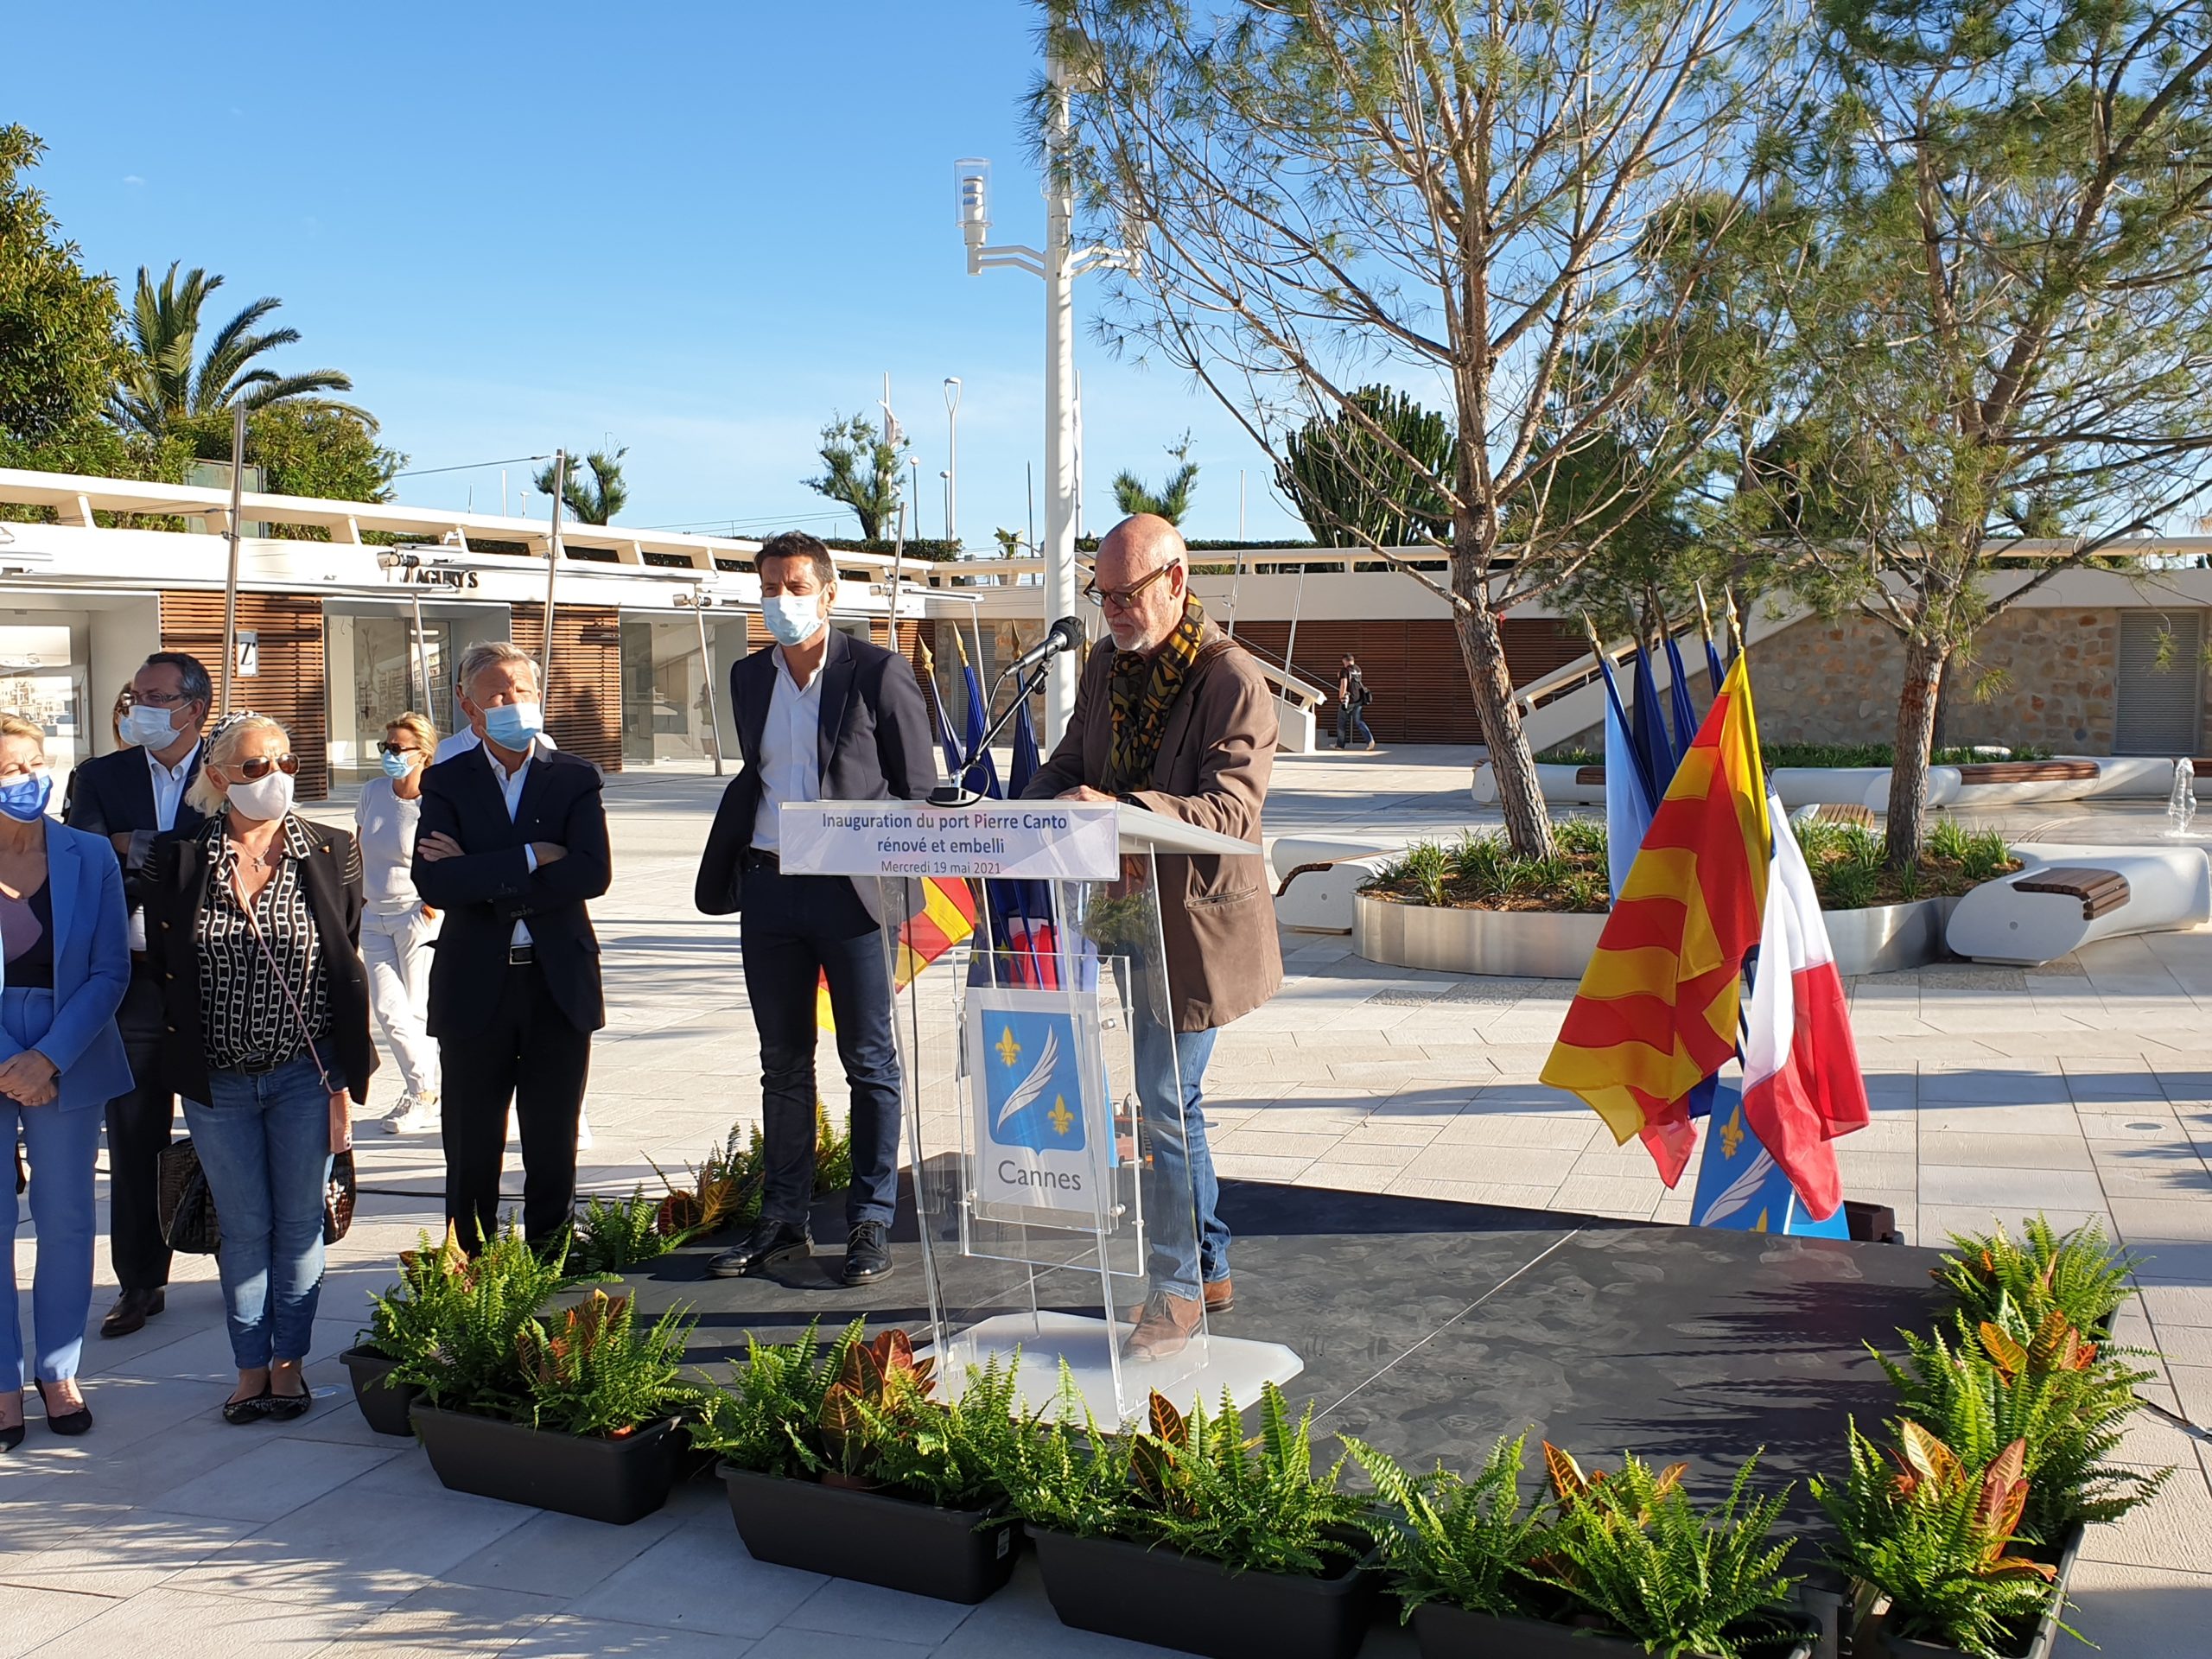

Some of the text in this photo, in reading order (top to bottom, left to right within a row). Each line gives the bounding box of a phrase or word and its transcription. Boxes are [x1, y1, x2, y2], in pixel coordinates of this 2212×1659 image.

[823, 812, 1067, 831] Inauguration du port Pierre Canto
[877, 836, 1004, 854] rénové et embelli
[881, 861, 1001, 874] Mercredi 19 mai 2021
[998, 1160, 1082, 1192] Cannes
